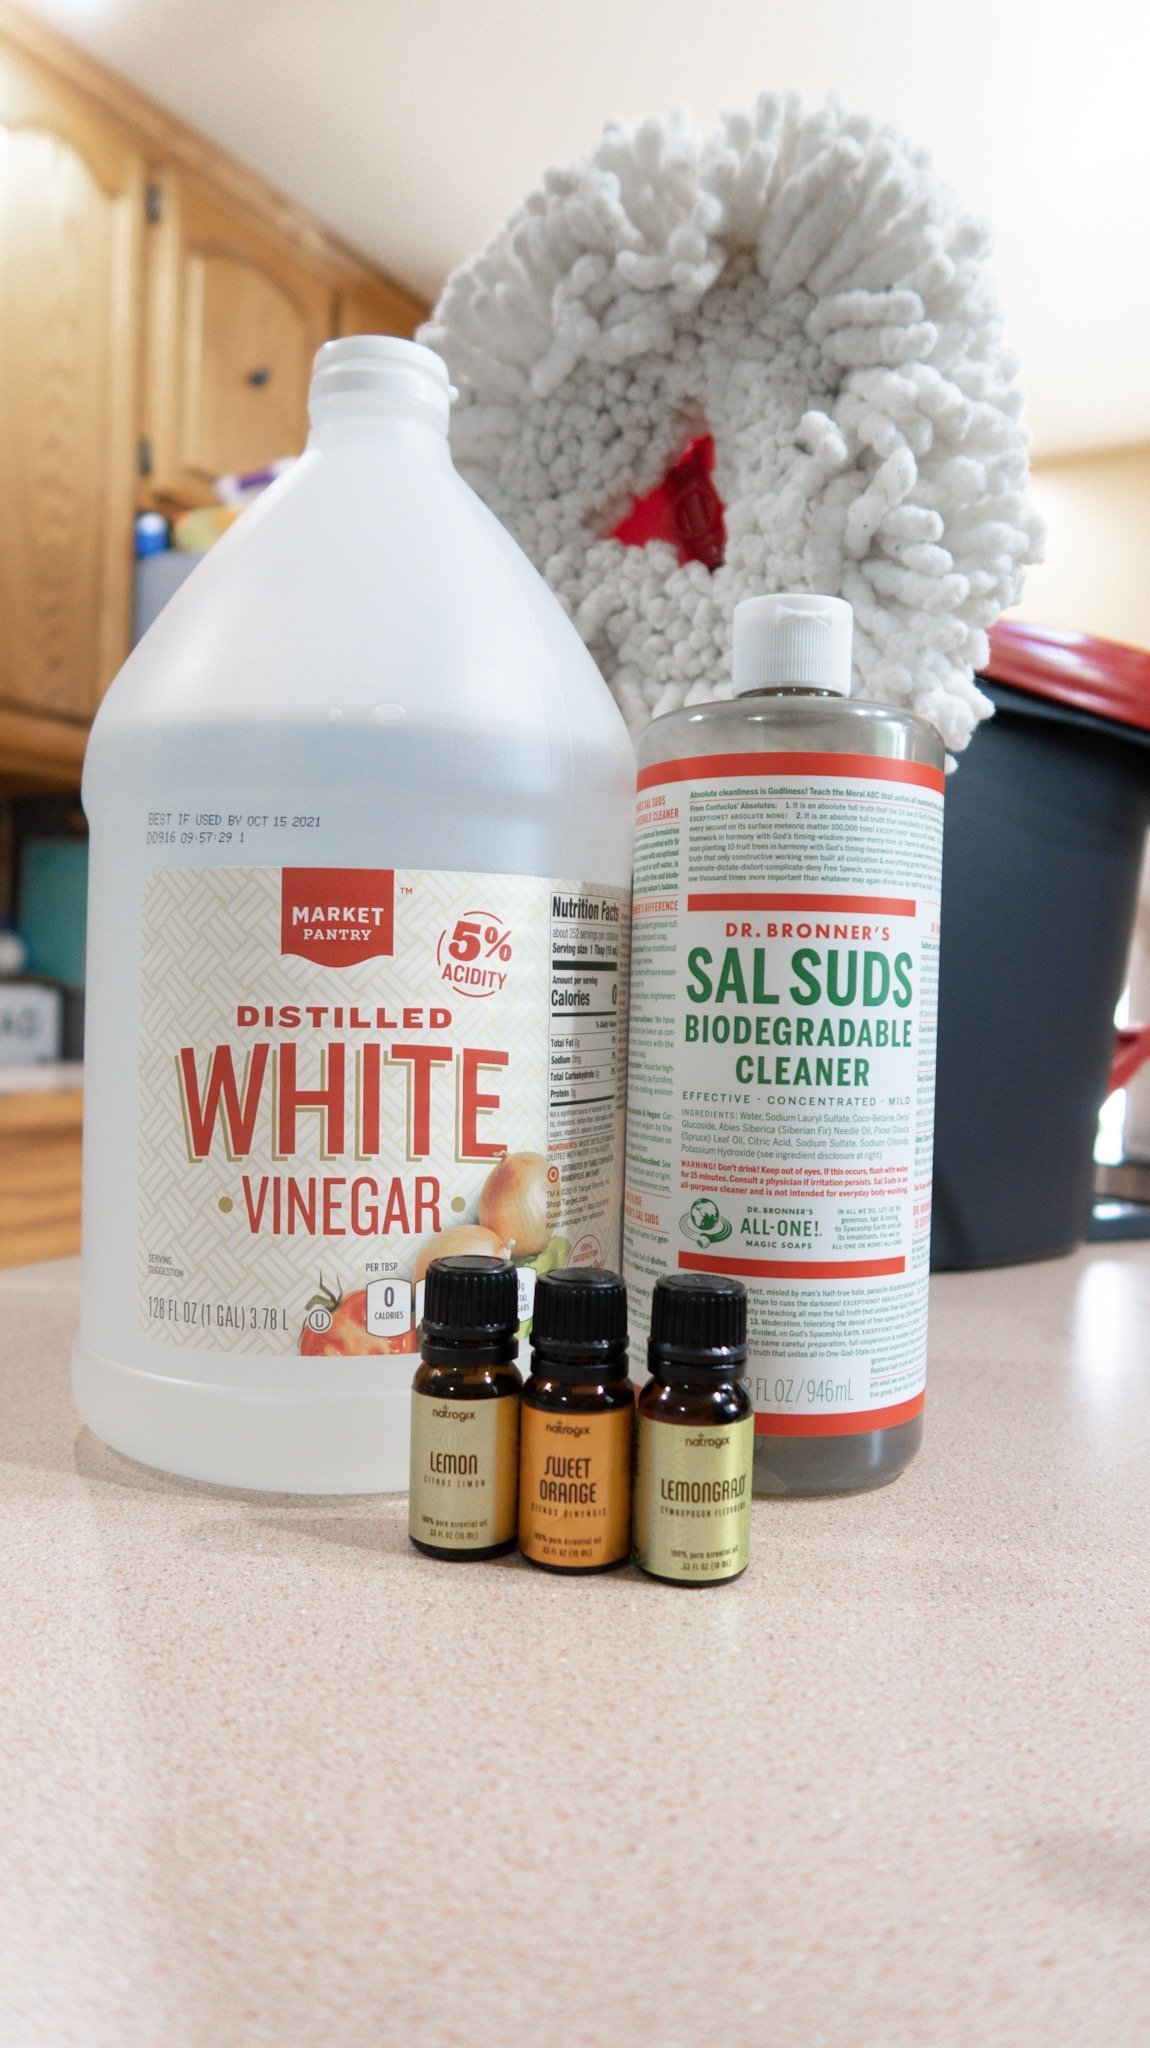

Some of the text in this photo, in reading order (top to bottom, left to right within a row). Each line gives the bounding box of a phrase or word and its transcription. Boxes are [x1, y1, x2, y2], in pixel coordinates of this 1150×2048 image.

[652, 796, 665, 806] SUDS
[690, 791, 717, 799] Absolute
[768, 787, 808, 795] Godliness!
[832, 788, 844, 796] the
[846, 789, 865, 797] Moral
[866, 791, 880, 799] ABC
[148, 812, 321, 827] BEST IF USED BY OCT 15 2021
[653, 808, 679, 819] CLEANER
[180, 832, 232, 844] 09:57:29
[239, 833, 244, 842] 1
[292, 906, 384, 926] MARKET
[553, 896, 619, 921] Nutrition Facts
[304, 929, 372, 941] PANTRY
[553, 928, 568, 938] about
[570, 928, 579, 939] 252
[726, 923, 890, 941] DR. BRONNER'S
[449, 921, 512, 962] 5%
[553, 943, 575, 956] Serving
[578, 944, 587, 954] size
[441, 963, 507, 989] ACIDITY
[553, 976, 573, 984] Amount
[686, 946, 780, 1004] SAL
[789, 947, 913, 1008] SUDS
[551, 984, 616, 1006] Calories 0
[237, 1005, 453, 1028] DISTILLED
[685, 1014, 912, 1047] BIODEGRADABLE
[551, 1039, 564, 1047] Total
[551, 1056, 570, 1064] Sodium
[550, 1071, 594, 1081] Total Carbohydrate
[736, 1055, 870, 1086] CLEANER
[550, 1089, 569, 1098] Protein
[682, 1091, 910, 1106] EFFECTIVE CONCENTRATED MILD
[176, 1043, 509, 1162] WHITE
[682, 1108, 821, 1124] INGREDIENTS: Water, Sodium Lauryl
[719, 1123, 859, 1136] Abies Siberica (Siberian Fir) Needle
[681, 1132, 826, 1148] (Spruce) Leaf Citric Sodium
[681, 1144, 863, 1161] Potassium Hydroxide (see ingredient disclosure at
[680, 1160, 716, 1170] WARNING!
[718, 1163, 737, 1172] Don't
[738, 1165, 760, 1173] drink!
[761, 1166, 779, 1176] Keep
[781, 1167, 794, 1175] out
[795, 1167, 803, 1175] of
[830, 1167, 843, 1175] this
[699, 1173, 728, 1182] minutes.
[729, 1175, 758, 1184] Consult
[766, 1178, 801, 1186] physician
[810, 1178, 843, 1186] irritation
[845, 1179, 872, 1187] persists.
[680, 1181, 718, 1192] all-purpose
[720, 1185, 747, 1194] cleaner
[750, 1188, 763, 1196] and
[766, 1188, 772, 1196] is
[790, 1189, 824, 1197] intended
[839, 1189, 869, 1198] everyday
[242, 1175, 442, 1236] VINEGAR
[763, 1207, 813, 1215] BRONNER'S
[740, 1218, 818, 1237] ALL-ONE!
[746, 1240, 777, 1248] MAGIC
[148, 1253, 172, 1265] SERVING
[365, 1262, 398, 1272] PER TBSP
[148, 1265, 184, 1278] SUGGESTION
[384, 1286, 394, 1307] 0
[148, 1296, 289, 1331] 128 FL OZ (1 GAL) 3.78 L
[374, 1311, 404, 1321] CALORIES
[756, 1378, 772, 1402] FL
[433, 1406, 475, 1422] natrogix
[546, 1421, 590, 1437] natrogix
[685, 1434, 730, 1449] natrogix
[430, 1451, 477, 1475] LEMON
[544, 1456, 591, 1479] SWEET
[424, 1475, 486, 1488] CITRUS LIMON
[540, 1479, 596, 1504] ORANGE
[436, 1519, 448, 1528] pure
